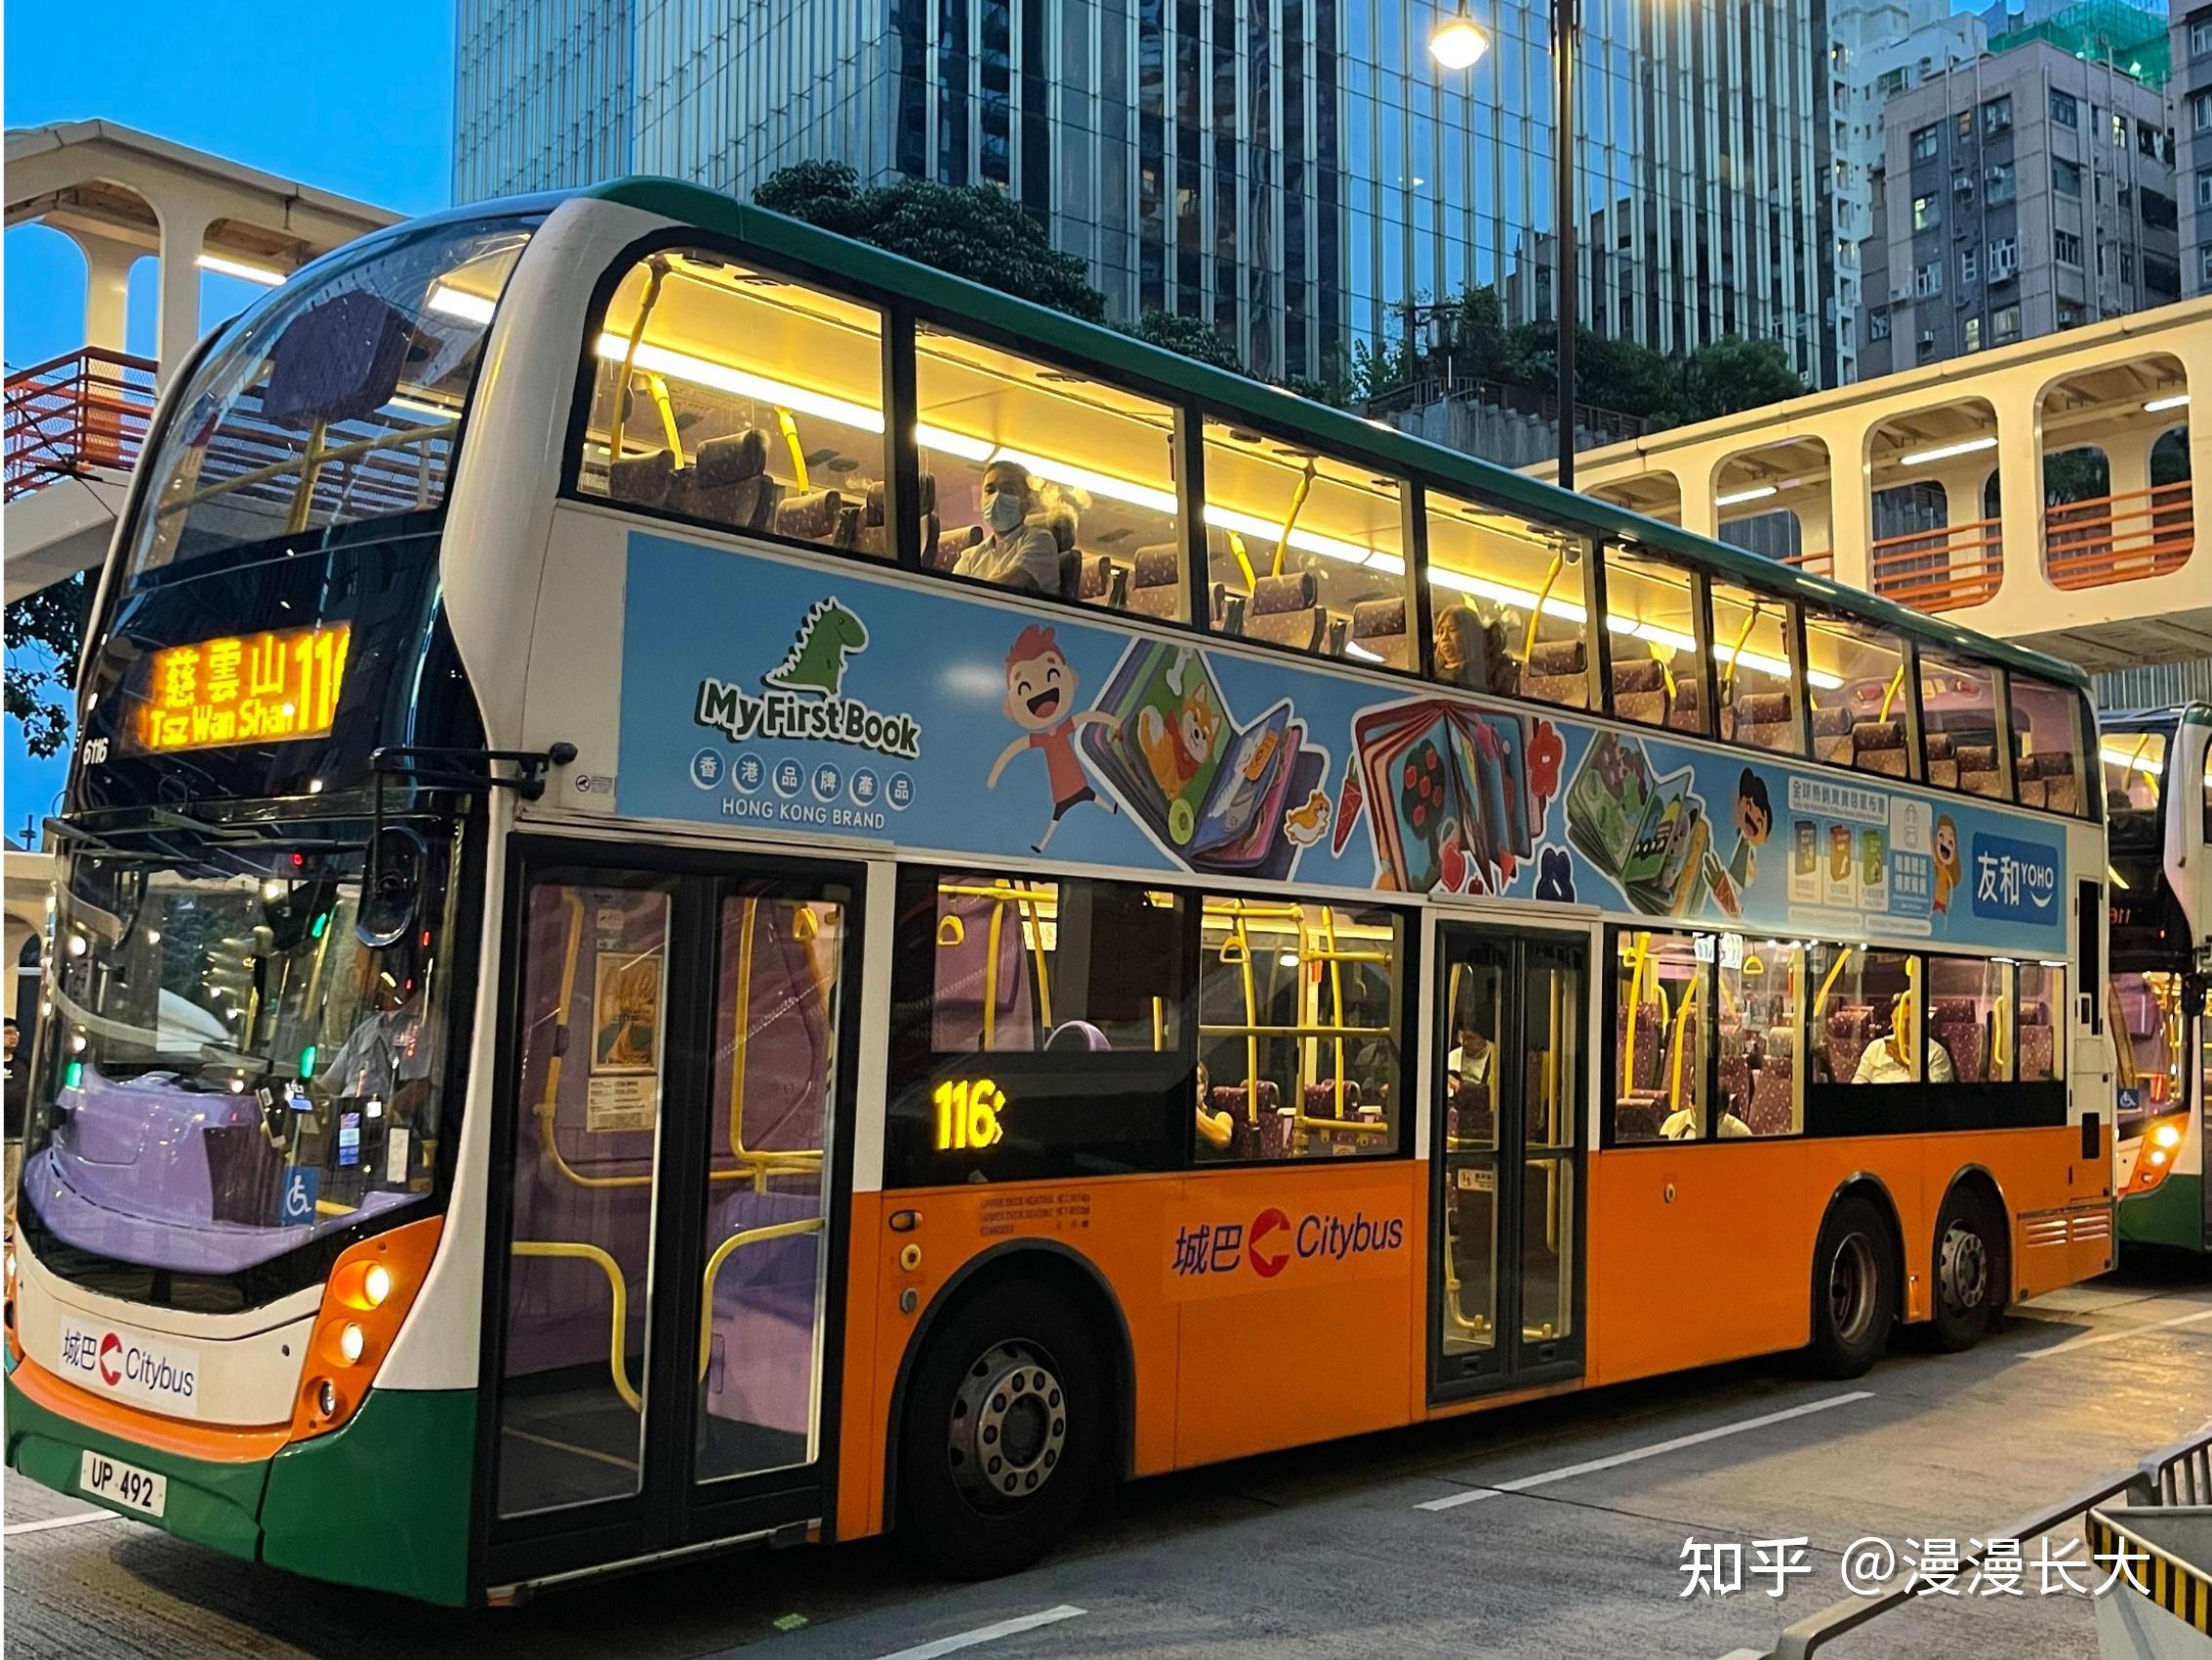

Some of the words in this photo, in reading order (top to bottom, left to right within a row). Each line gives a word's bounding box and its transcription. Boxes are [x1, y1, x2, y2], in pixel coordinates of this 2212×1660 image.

[165, 635, 286, 709] 慈雲山
[150, 710, 189, 748] Tsz
[192, 705, 234, 743] Wan
[238, 698, 294, 739] Shan
[701, 679, 764, 740] My
[764, 692, 841, 736] First
[844, 699, 921, 757] Book
[83, 737, 109, 765] 6116
[722, 797, 774, 819] HONG
[780, 804, 828, 825] KONG
[833, 810, 885, 830] BRAND
[1978, 851, 2020, 906] 友和
[2021, 862, 2054, 889] YOHO
[934, 1078, 997, 1150] 116
[1171, 1223, 1243, 1276] 城巴
[1296, 1212, 1403, 1260] Citybus
[61, 1329, 98, 1371] 城巴
[125, 1348, 194, 1397] Citybus
[92, 1458, 113, 1491] UP
[119, 1471, 153, 1508] 492
